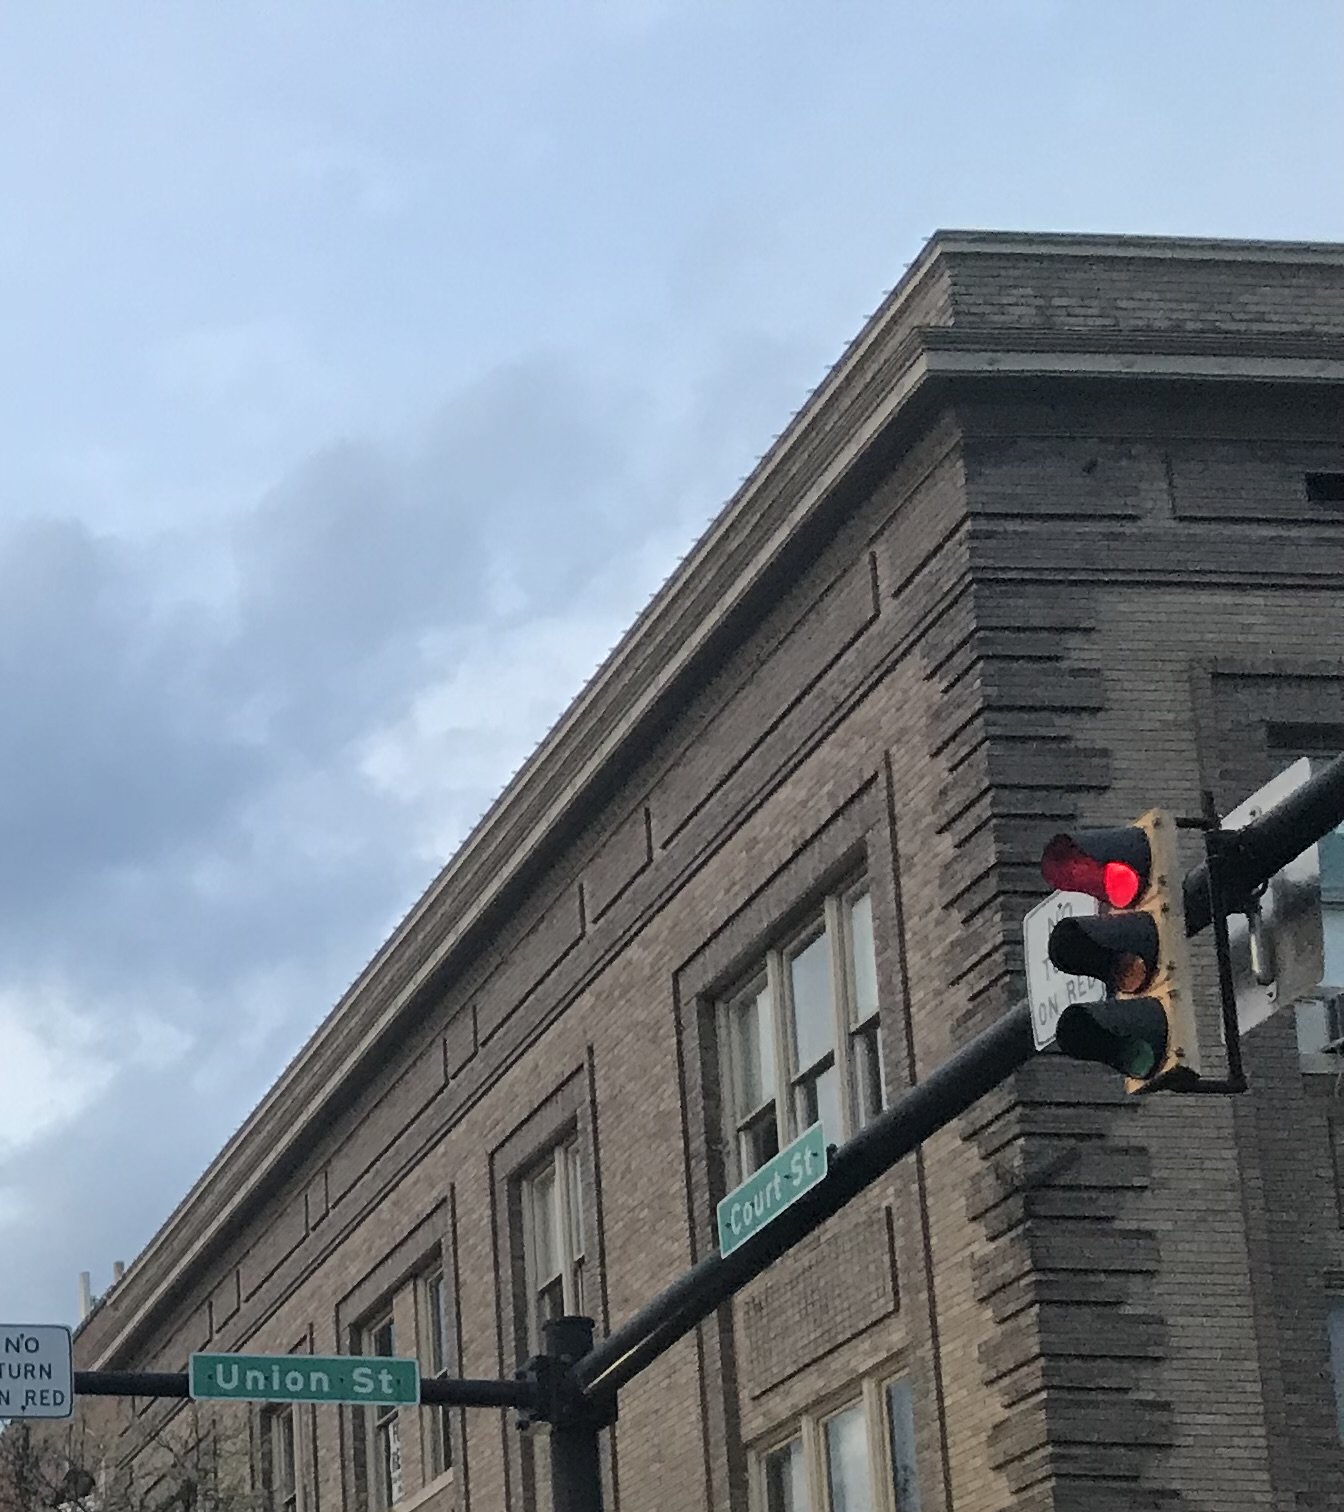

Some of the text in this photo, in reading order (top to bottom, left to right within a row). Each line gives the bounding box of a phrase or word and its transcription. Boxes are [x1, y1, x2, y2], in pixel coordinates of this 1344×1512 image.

[1038, 993, 1059, 1026] ON
[731, 1145, 813, 1235] Court St
[5, 1336, 40, 1353] NO
[215, 1363, 393, 1394] Union St
[25, 1388, 65, 1407] RED
